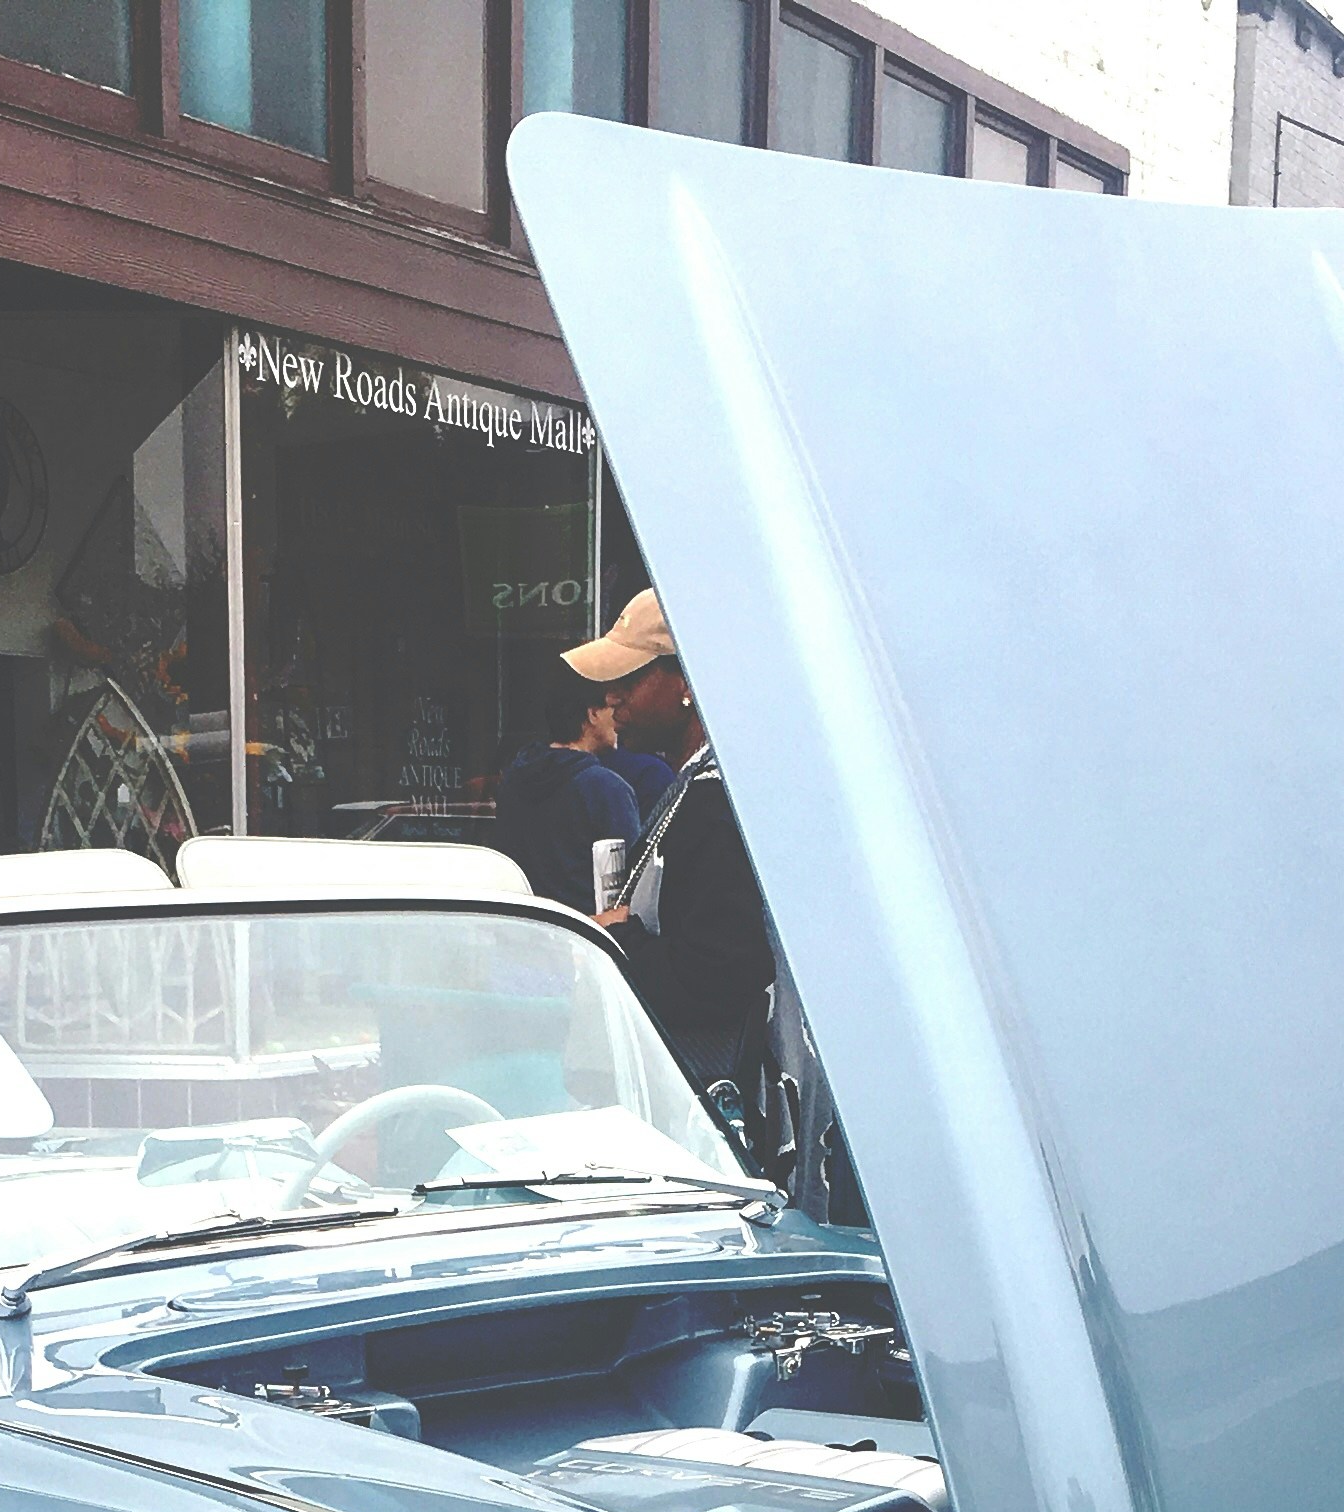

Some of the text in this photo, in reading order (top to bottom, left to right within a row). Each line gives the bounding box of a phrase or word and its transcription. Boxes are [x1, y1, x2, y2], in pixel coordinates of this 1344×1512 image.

[256, 332, 584, 455] New Roads Antique Mall
